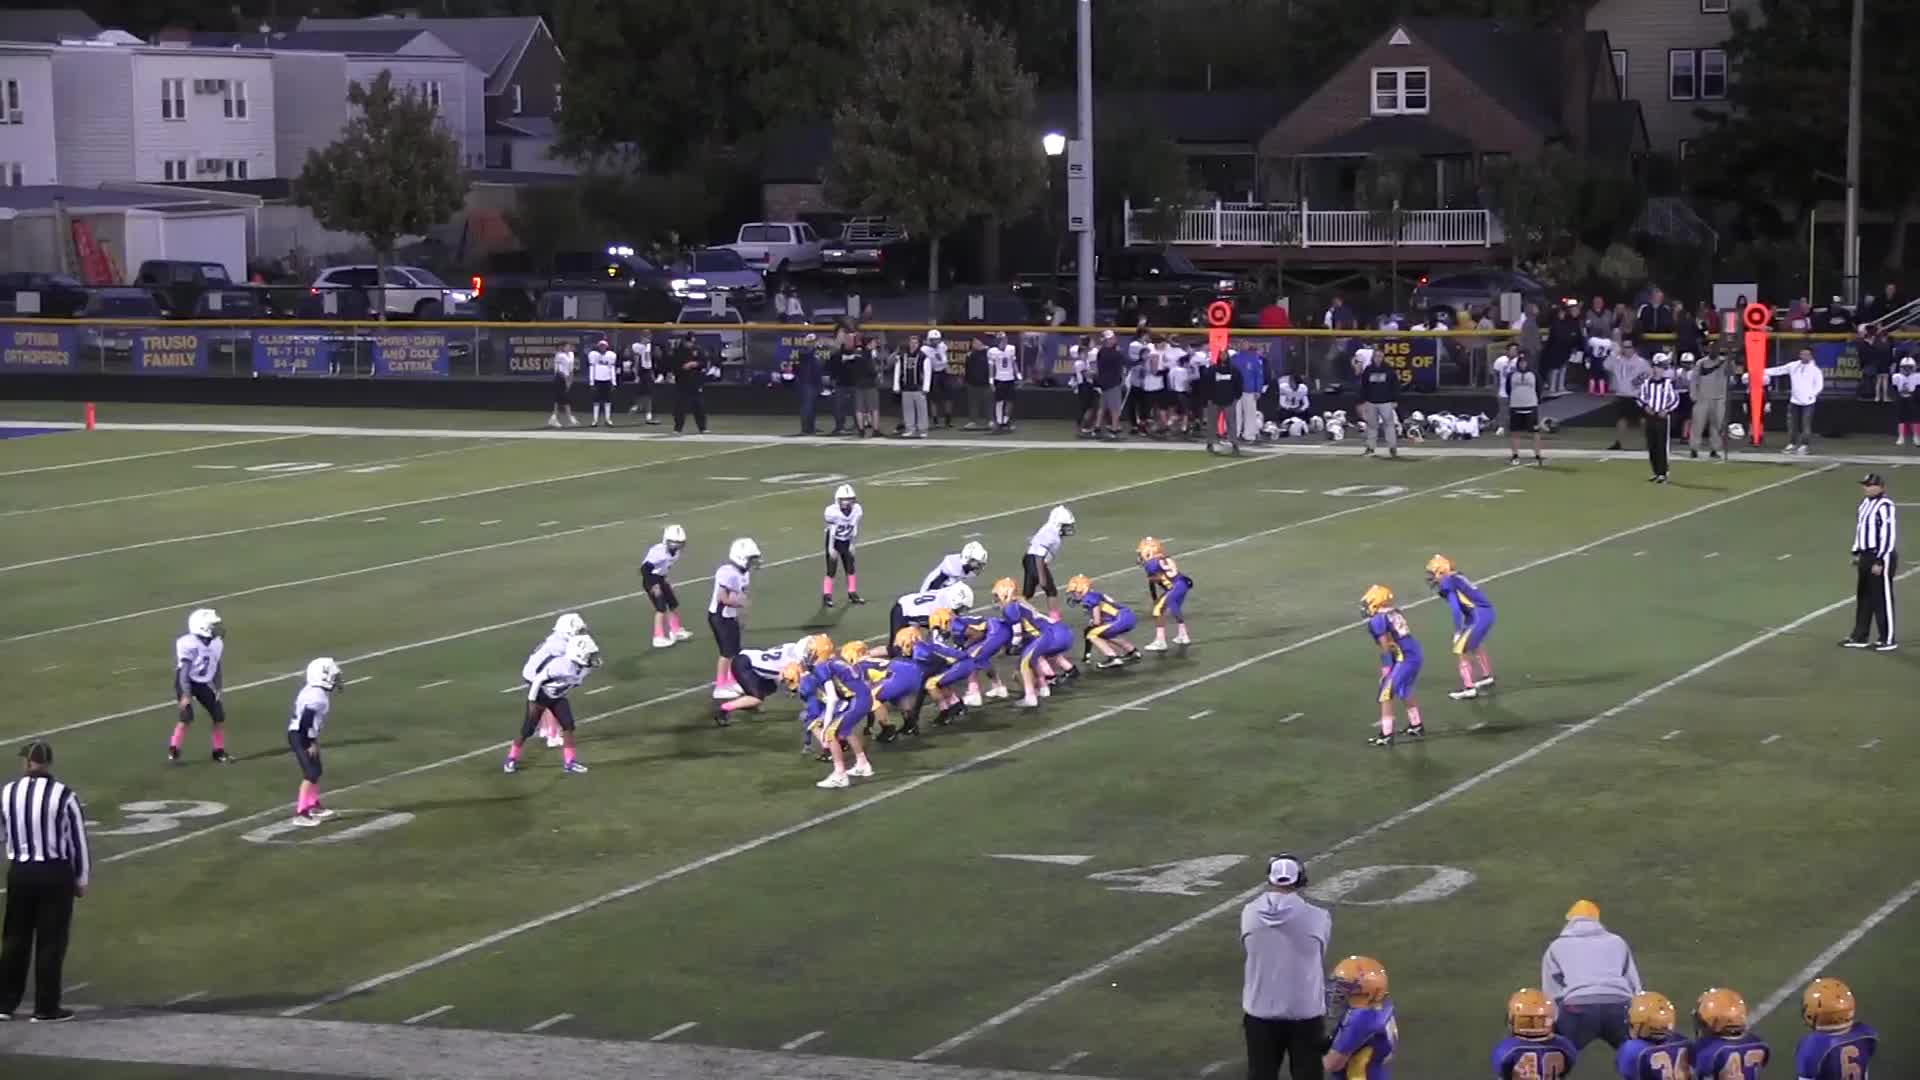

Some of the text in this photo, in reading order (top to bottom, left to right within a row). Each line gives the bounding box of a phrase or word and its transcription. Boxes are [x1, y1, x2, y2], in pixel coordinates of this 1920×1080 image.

[142, 336, 197, 349] TRUSIO
[143, 352, 196, 367] FAMILY
[510, 357, 541, 371] CLASS
[1412, 356, 1434, 368] OF
